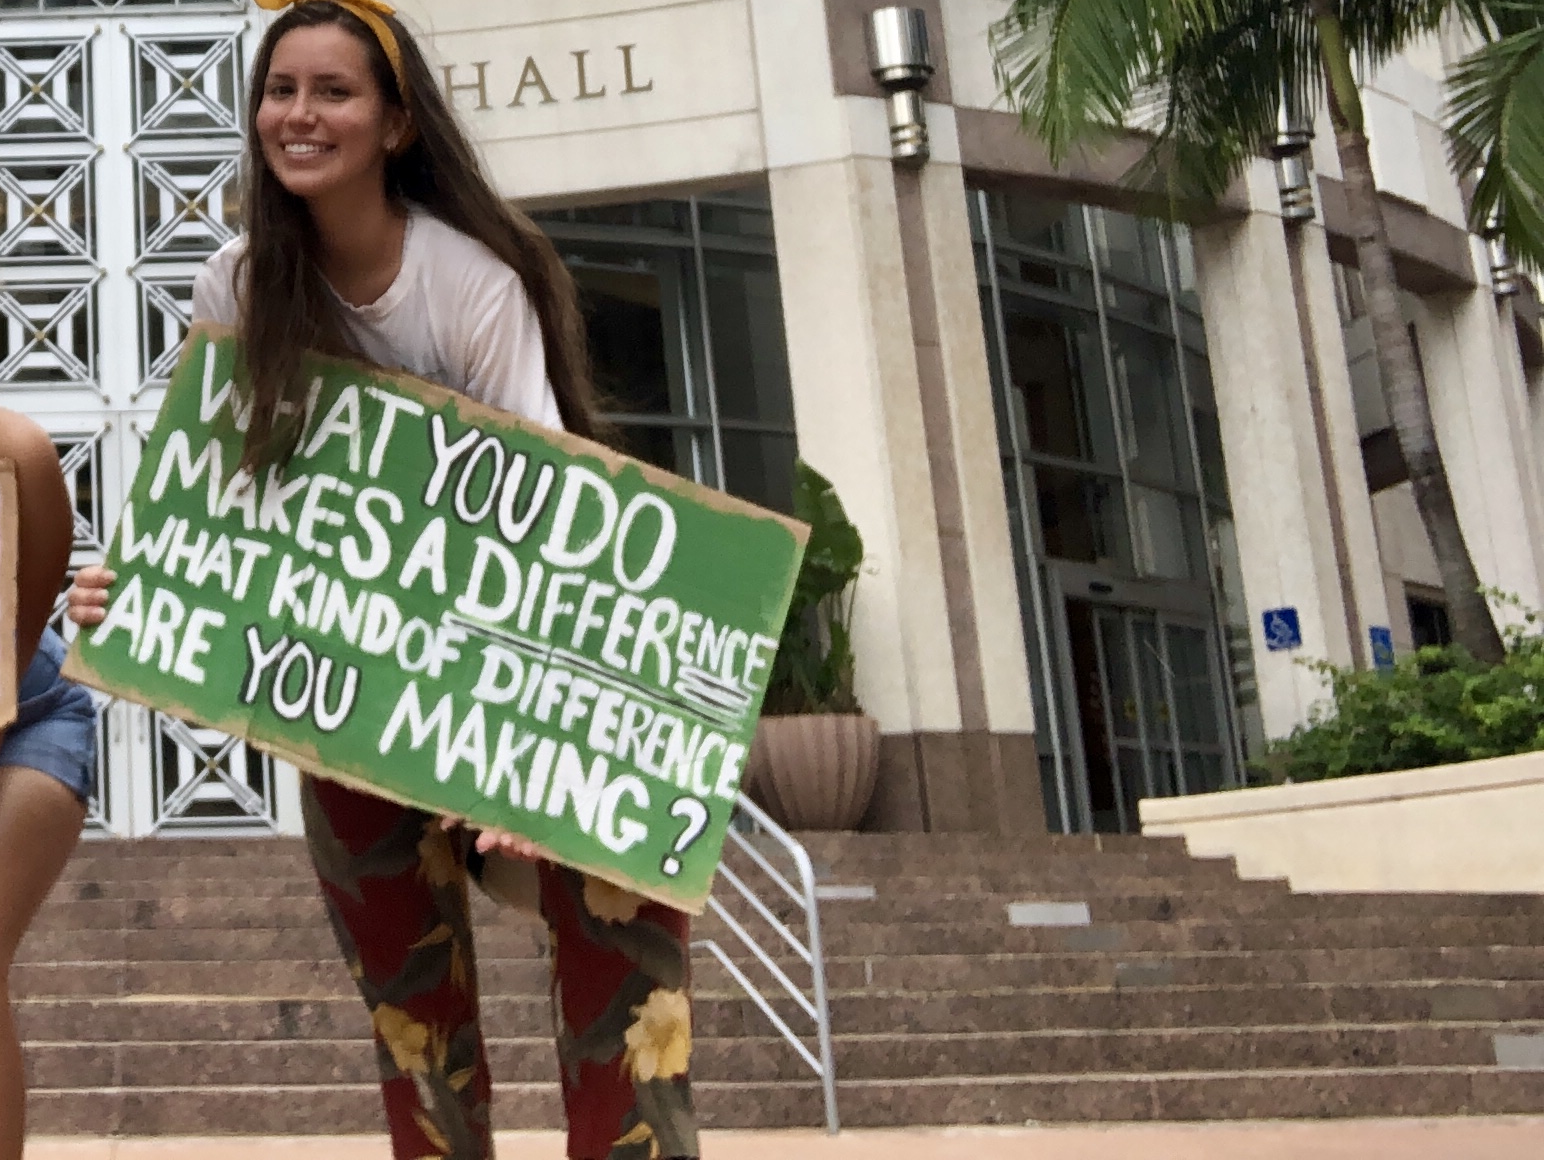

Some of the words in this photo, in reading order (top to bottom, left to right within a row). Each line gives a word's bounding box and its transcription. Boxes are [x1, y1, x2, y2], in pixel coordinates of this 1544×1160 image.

[440, 44, 653, 111] HALL
[149, 429, 404, 581] MAKES
[399, 517, 447, 595] A
[455, 536, 778, 690] DIFFERENCE
[424, 412, 555, 544] YOU
[540, 464, 677, 593] DO
[90, 572, 227, 685] ARE
[239, 625, 360, 732] YOU
[120, 501, 271, 602] WHAT
[471, 643, 747, 801] DIFFERENCE
